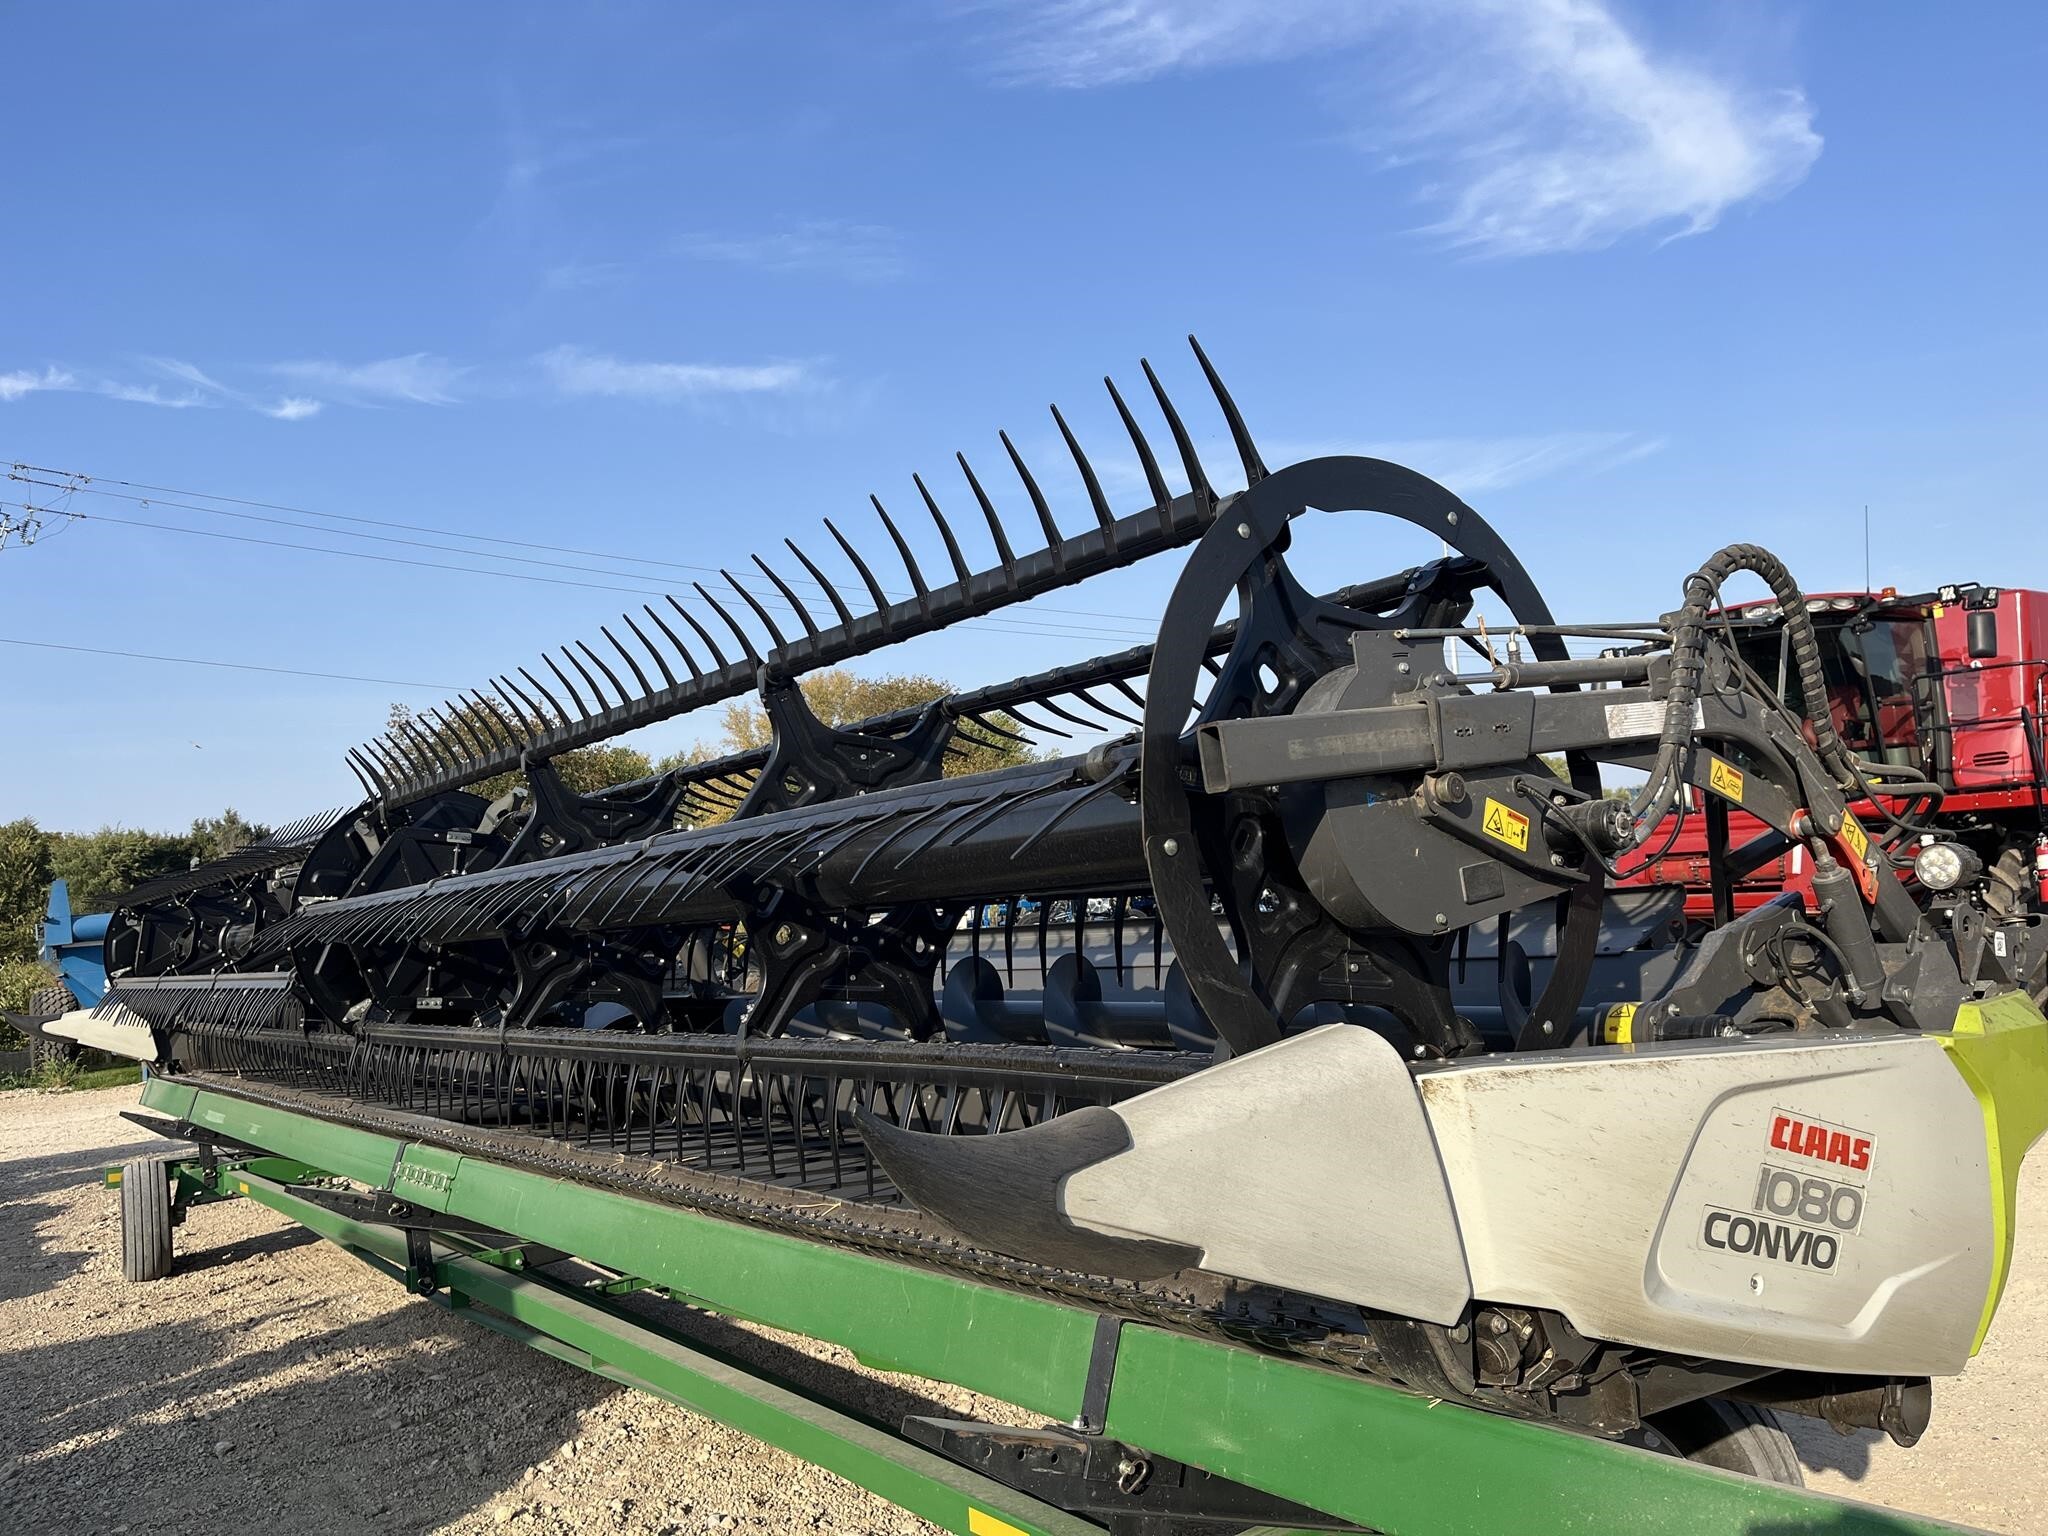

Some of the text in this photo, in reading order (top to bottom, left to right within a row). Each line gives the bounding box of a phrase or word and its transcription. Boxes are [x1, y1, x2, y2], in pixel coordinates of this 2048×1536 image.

[1770, 1116, 1871, 1171] CLAAS
[1754, 1167, 1863, 1230] 1080
[1704, 1211, 1838, 1269] CONVIO
